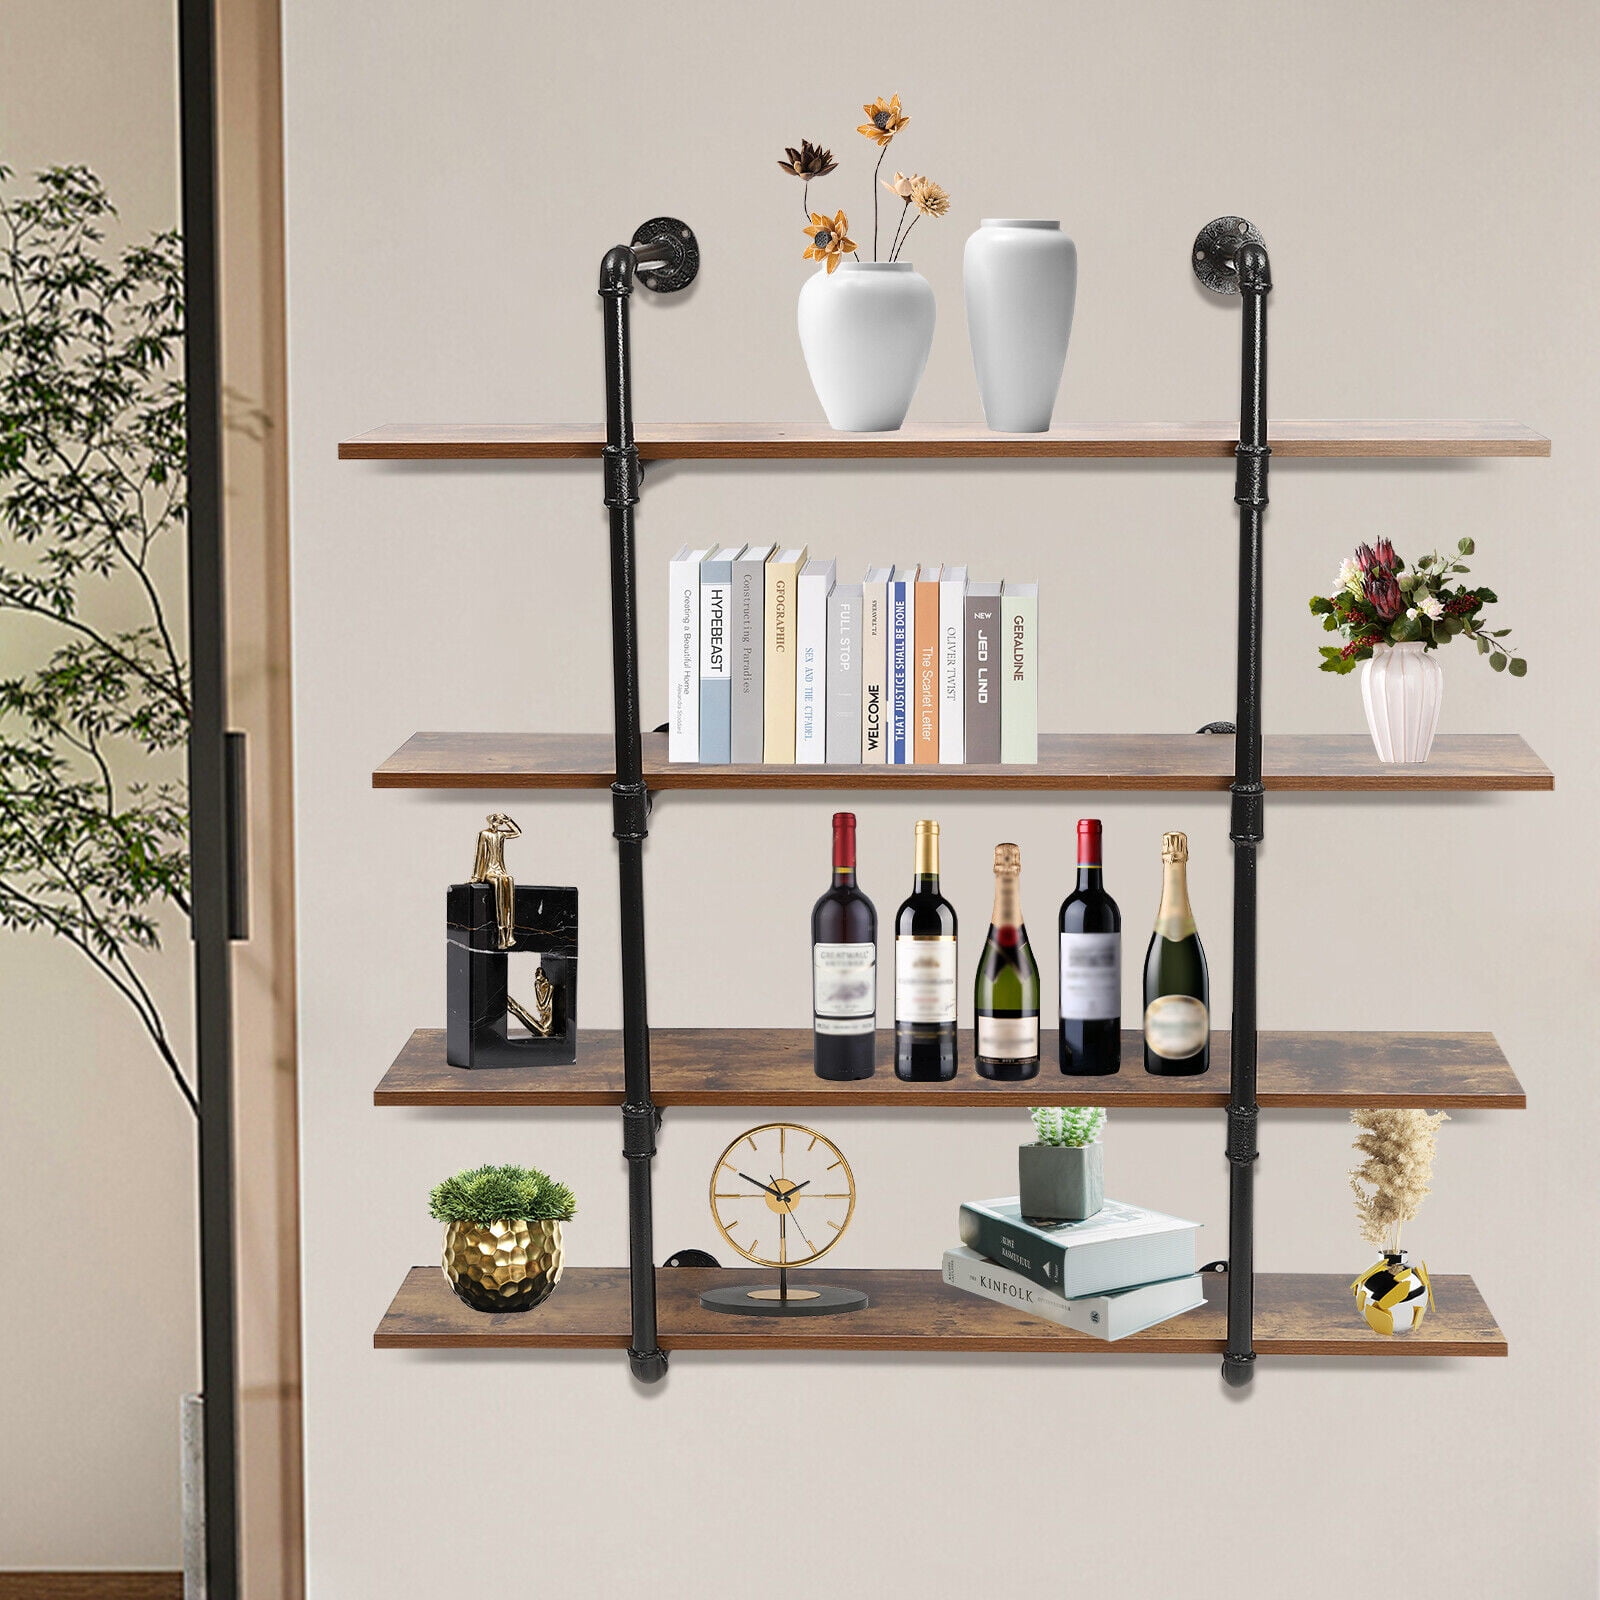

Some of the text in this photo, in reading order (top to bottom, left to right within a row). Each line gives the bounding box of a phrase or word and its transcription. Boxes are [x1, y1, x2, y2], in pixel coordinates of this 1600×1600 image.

[682, 589, 692, 624] Creating
[711, 589, 723, 673] HYPEBEAST
[742, 574, 752, 694] Constructing Paradies
[840, 603, 850, 634] FULL
[683, 634, 692, 668] Beautiful
[804, 667, 814, 683] AND
[895, 601, 905, 741] THAT JUSTICE SHALL BE DONE
[946, 627, 956, 702] OLIVER TWIST
[978, 630, 988, 704] JED LIND
[1013, 615, 1024, 681] GERALDINE
[683, 671, 691, 695] Home
[804, 686, 813, 702] THE
[921, 646, 934, 741] The Scarlet Letter
[868, 684, 880, 751] WELCOME
[979, 1275, 1034, 1303] KINFOLK
